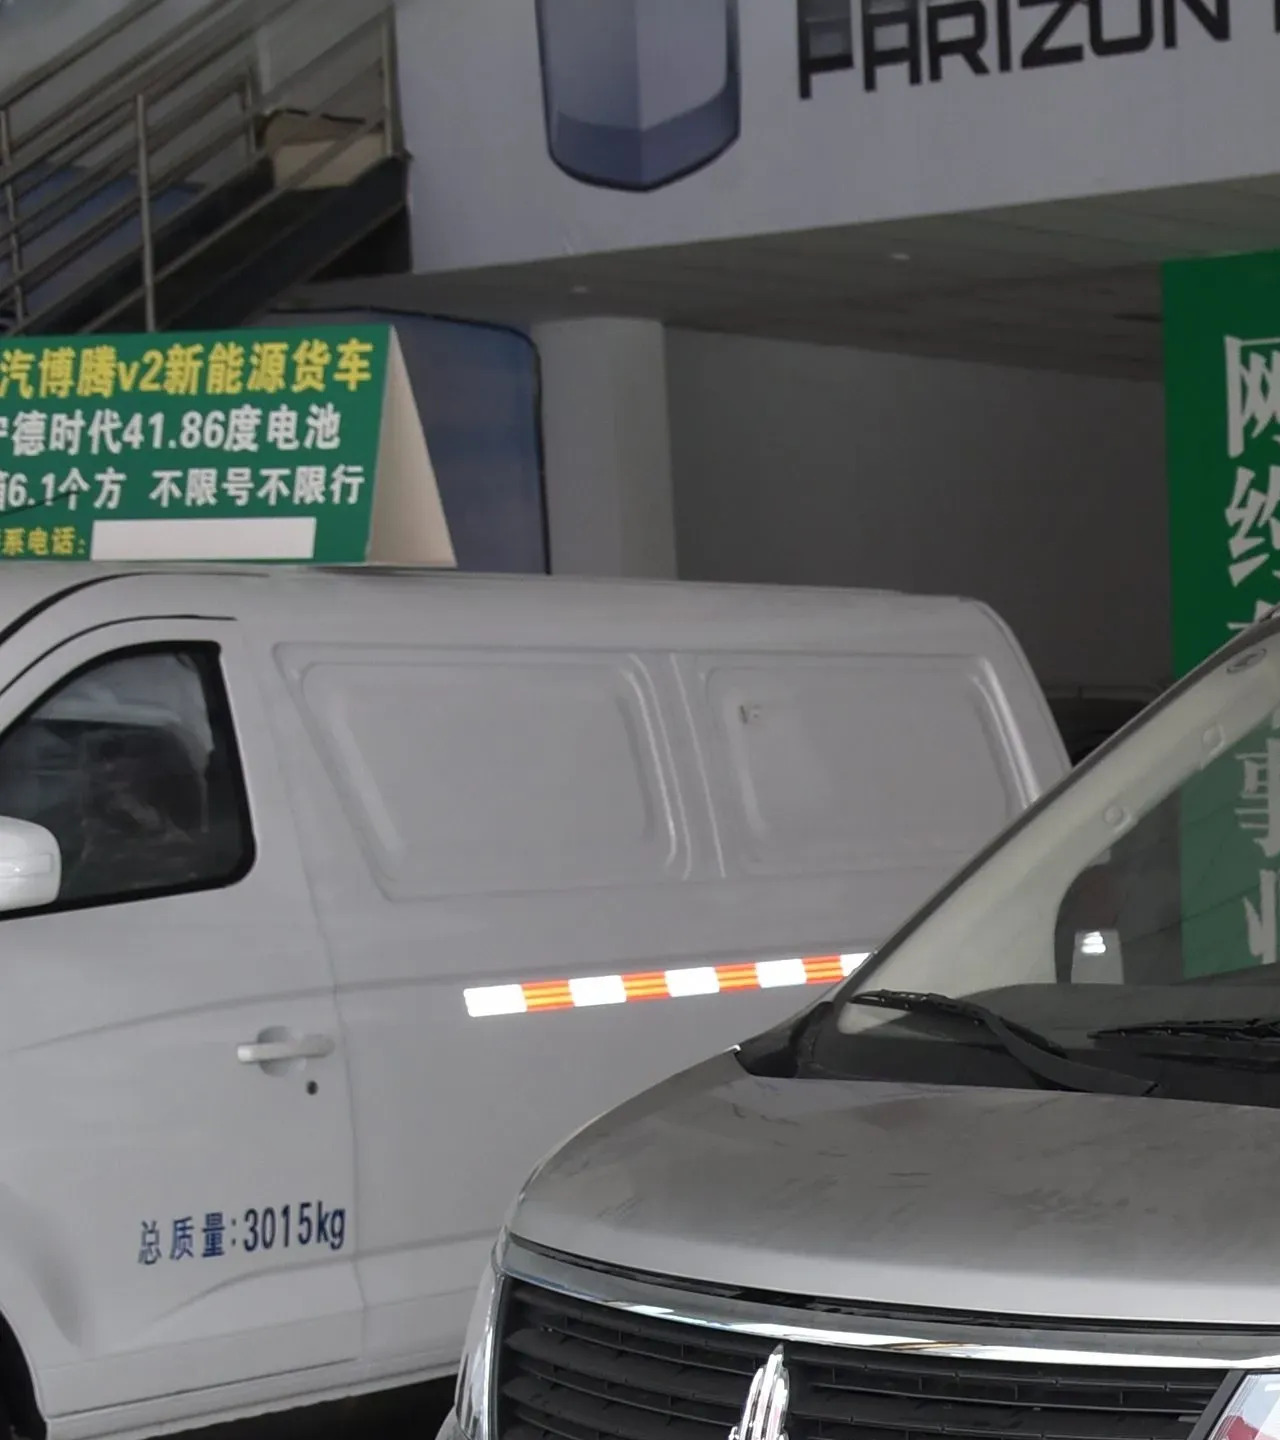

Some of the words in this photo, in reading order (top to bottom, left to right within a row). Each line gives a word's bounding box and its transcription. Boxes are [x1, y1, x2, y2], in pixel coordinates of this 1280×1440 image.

[149, 464, 365, 507] 不限号不限行
[138, 1201, 346, 1265] 总质量:3015kg
